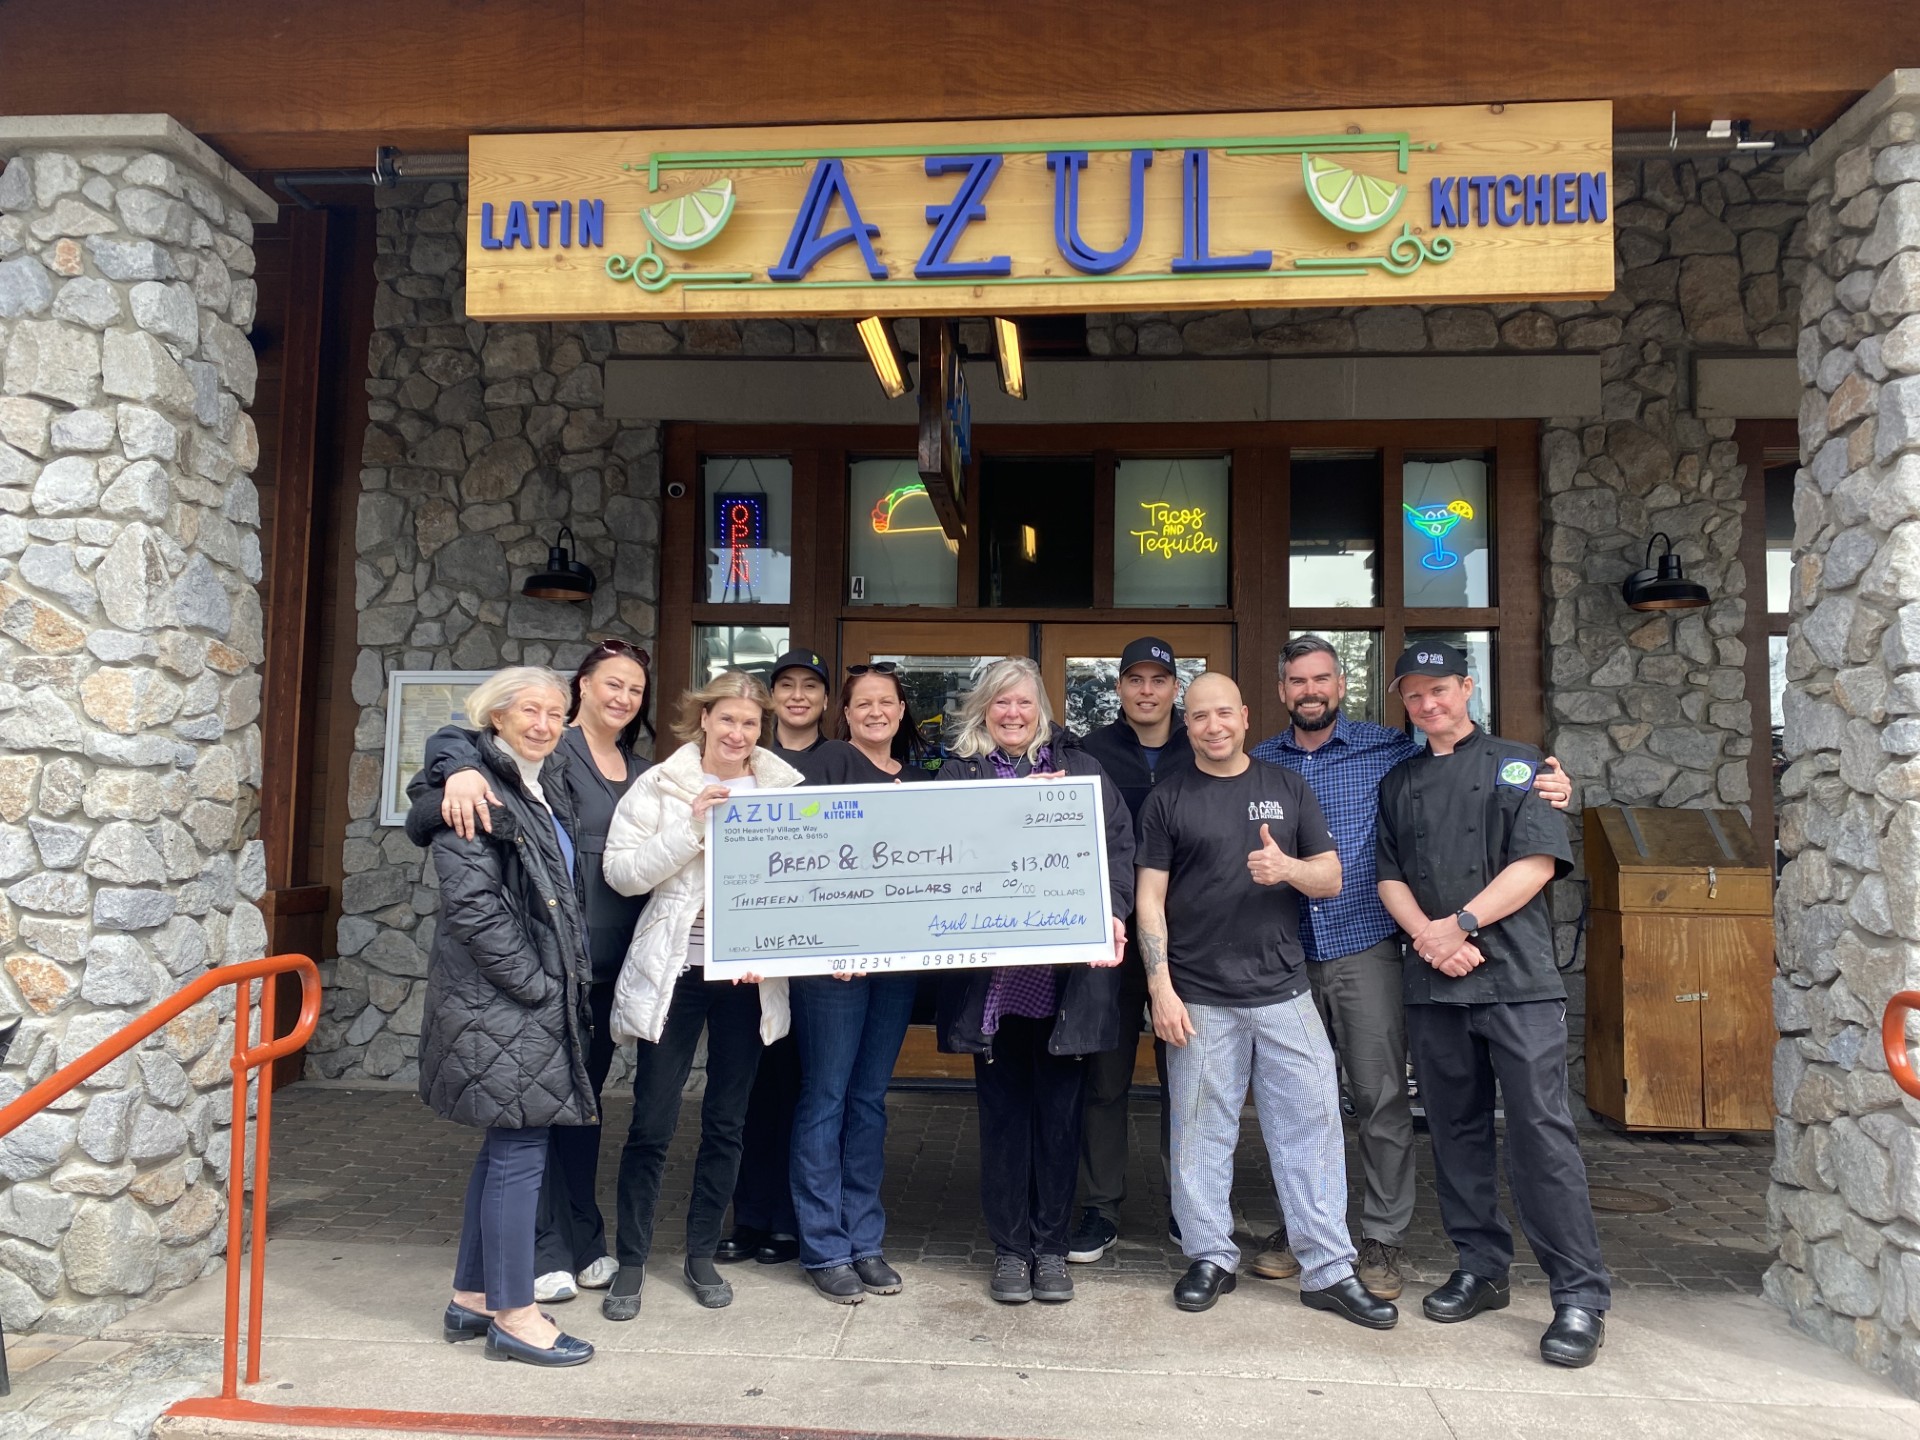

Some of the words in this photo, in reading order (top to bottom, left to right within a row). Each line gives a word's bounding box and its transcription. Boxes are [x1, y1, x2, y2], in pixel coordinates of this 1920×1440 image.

[481, 199, 604, 249] LATIN
[767, 147, 1272, 281] AZUL
[1430, 172, 1607, 228] KITCHEN
[1141, 502, 1206, 529] Tacos
[1163, 524, 1185, 536] AND
[732, 505, 749, 583] OPEN
[852, 577, 863, 598] 4
[1038, 790, 1077, 802] 1000
[832, 800, 859, 810] LATIN
[1259, 801, 1282, 809] AZUL
[724, 802, 801, 823] AZUL
[824, 810, 864, 820] KITCHEN
[1025, 812, 1084, 825] 3/21/2025
[742, 826, 775, 835] Heavenly
[777, 826, 800, 834] Village
[802, 825, 818, 833] Way
[724, 835, 746, 843] South
[769, 851, 831, 878] BREAD
[839, 844, 859, 871] &
[872, 841, 954, 870] BROTH
[885, 883, 952, 897] DOLLARS
[961, 881, 983, 895] and
[1043, 889, 1086, 897] DOLLARS
[928, 912, 968, 938] Azul
[971, 912, 1018, 930] Latin
[1023, 908, 1087, 928] Kitchen
[755, 935, 785, 949] LOVE
[788, 933, 825, 947] AZUL
